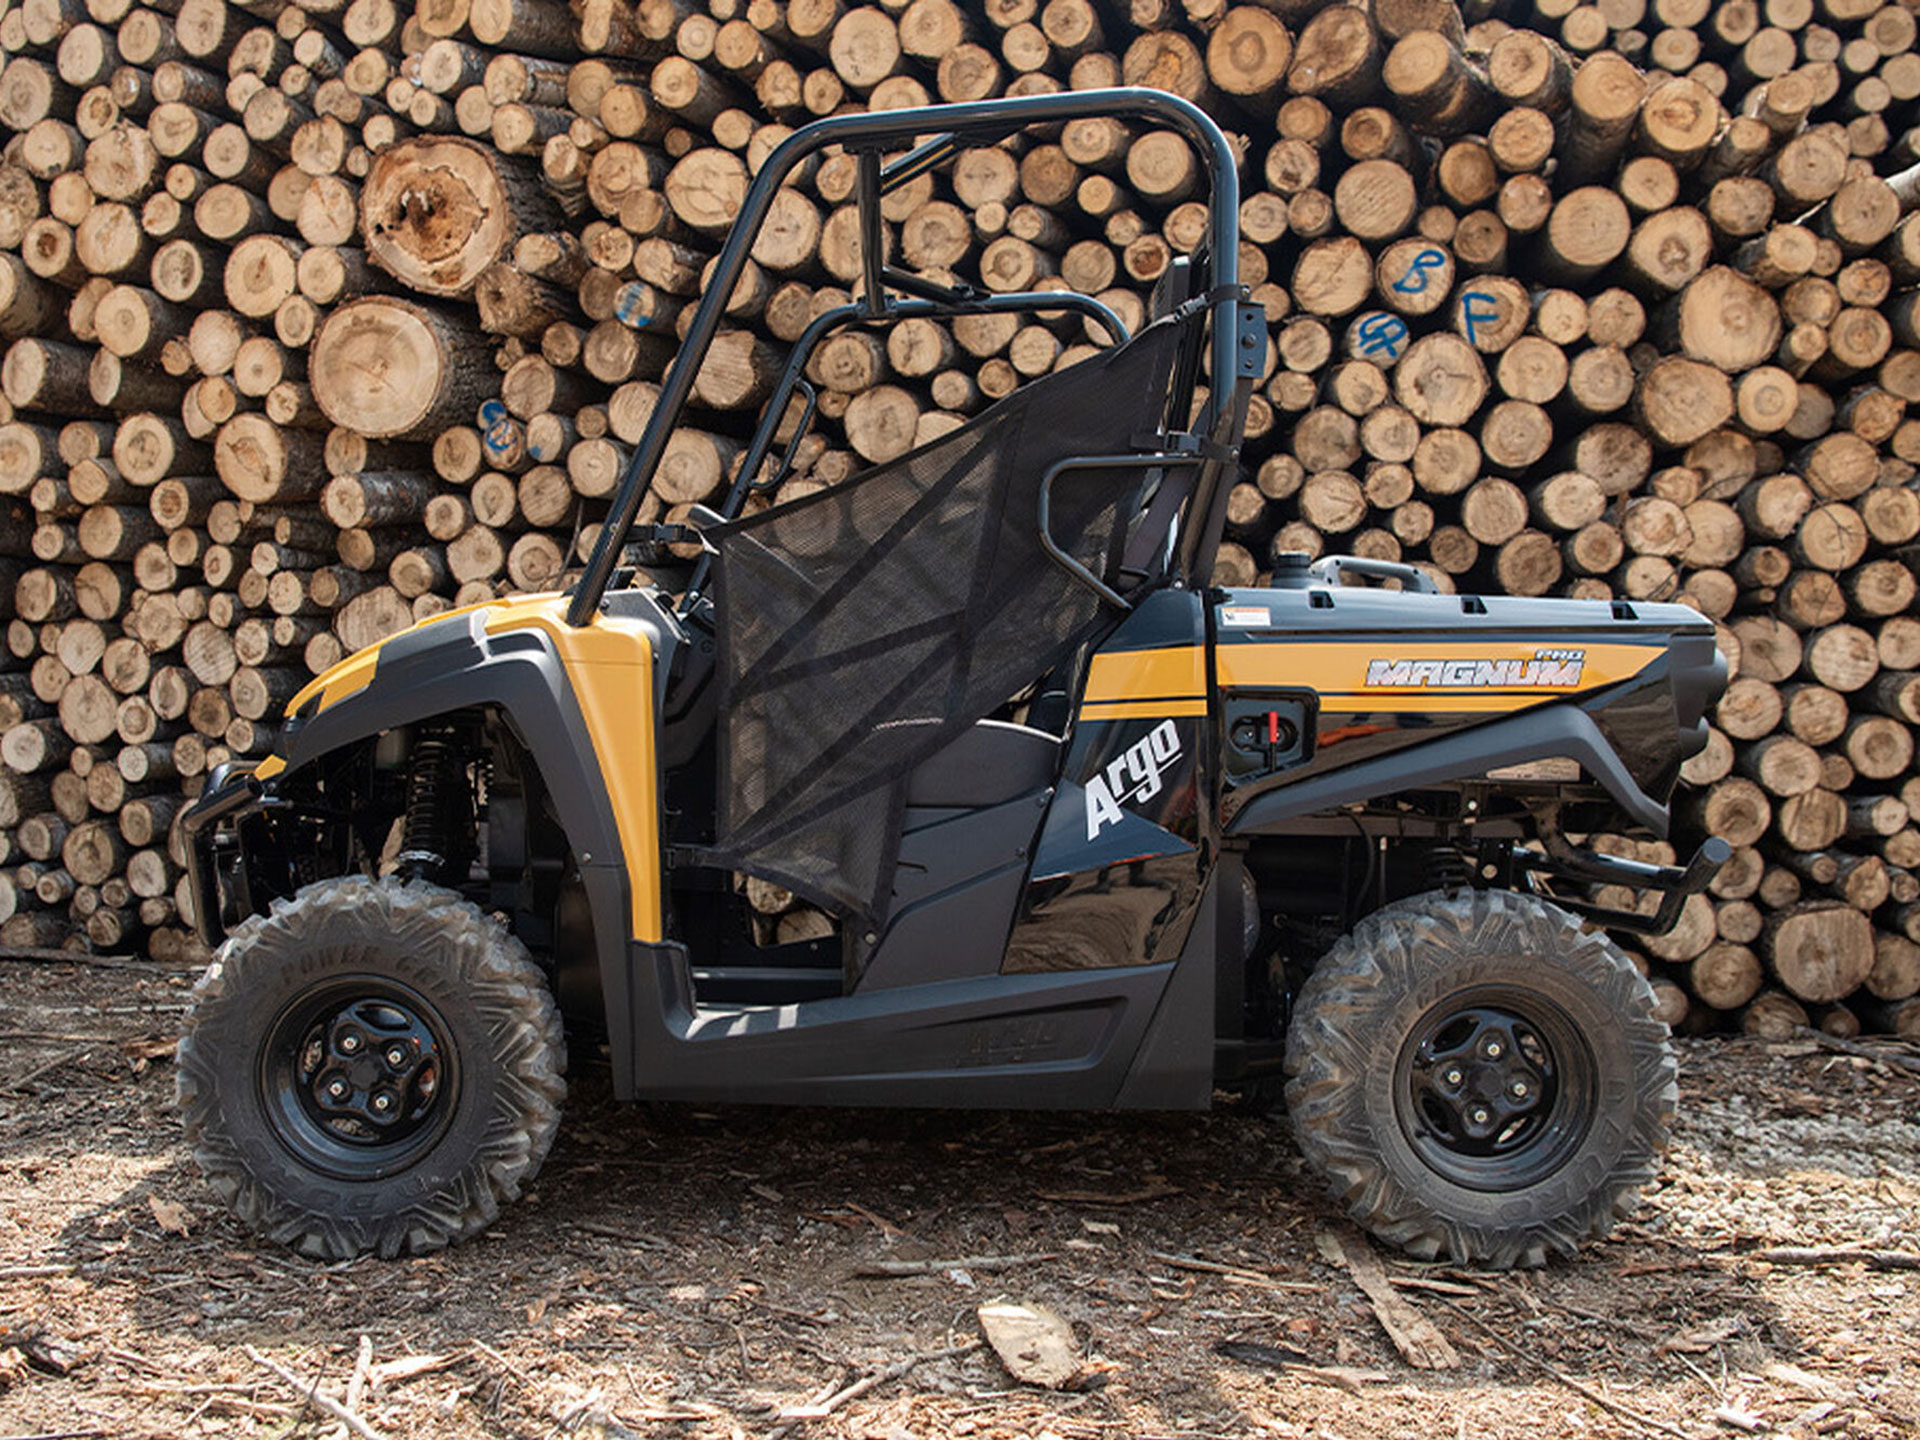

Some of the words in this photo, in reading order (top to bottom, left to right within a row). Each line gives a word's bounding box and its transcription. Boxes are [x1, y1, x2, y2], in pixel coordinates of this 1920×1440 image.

[1462, 292, 1499, 344] F
[1364, 658, 1584, 687] MAGNUM
[1534, 649, 1585, 661] PRO
[1085, 719, 1183, 841] Argo
